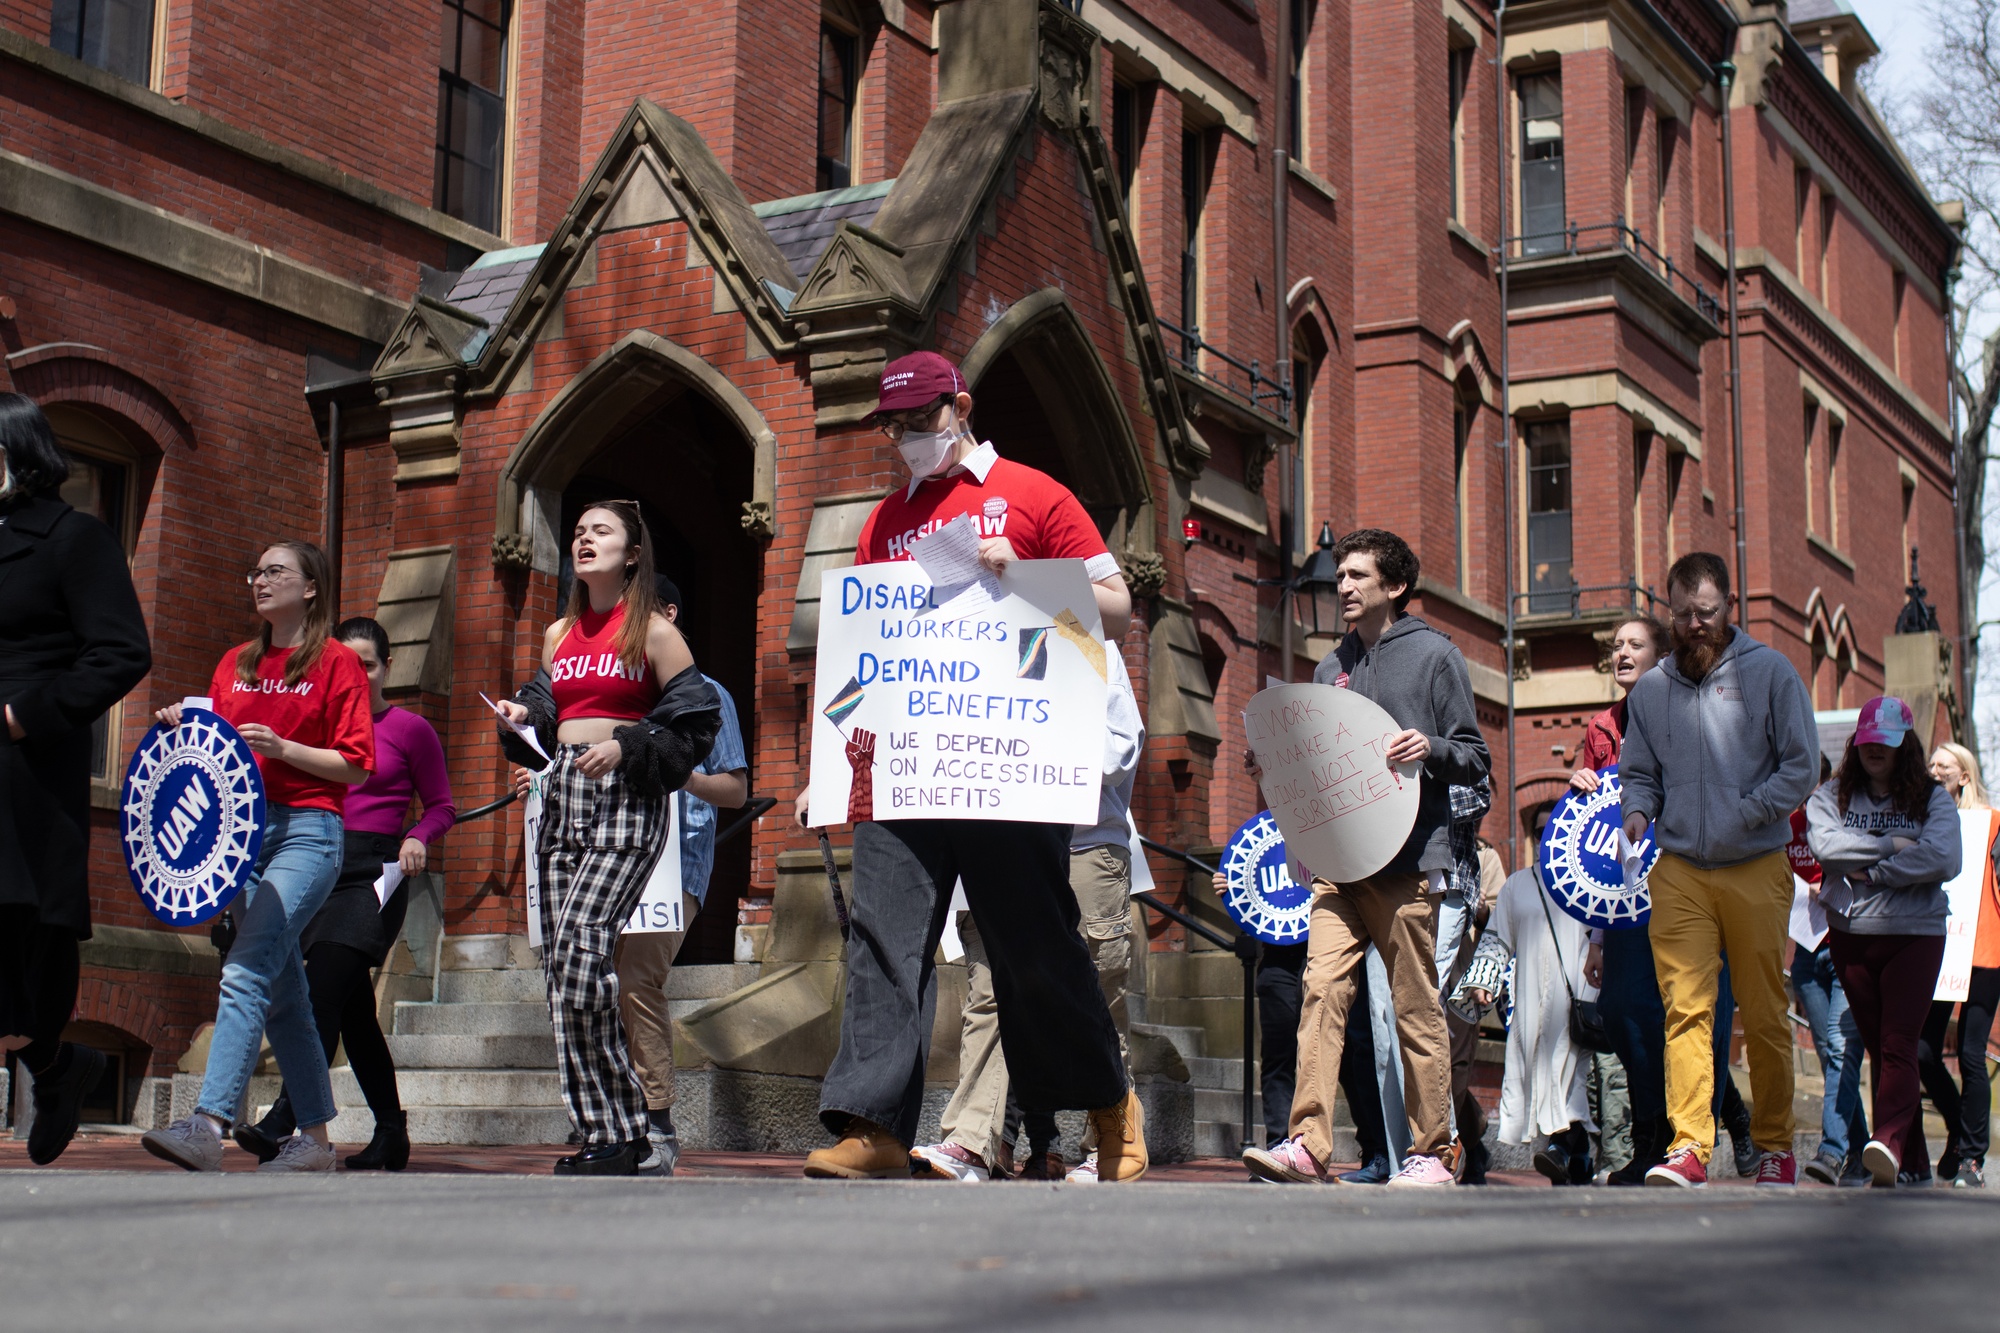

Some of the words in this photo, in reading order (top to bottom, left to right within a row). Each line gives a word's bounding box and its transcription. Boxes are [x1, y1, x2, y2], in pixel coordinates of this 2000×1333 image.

[841, 576, 940, 615] DISABL
[881, 619, 1008, 642] WORKERS
[858, 652, 980, 686] DEMAND
[908, 690, 1050, 723] BENEFITS
[1260, 699, 1325, 737] WORK
[889, 732, 920, 750] WE
[936, 733, 1030, 757] DEPEND
[1276, 732, 1330, 768] MAKE
[1335, 722, 1353, 744] A
[179, 748, 206, 759] IMPLEMENT
[207, 757, 226, 785] WORKERS
[889, 756, 917, 776] ON
[933, 758, 1089, 786] ACCESSIBLE
[1311, 750, 1355, 792] NOT
[892, 787, 1001, 808] BENEFITS
[1293, 764, 1403, 829] SURVIVE!
[157, 773, 211, 860] UAW
[1844, 810, 1868, 829] BAR
[1870, 811, 1915, 829] HARBOR
[1260, 863, 1300, 894] UA
